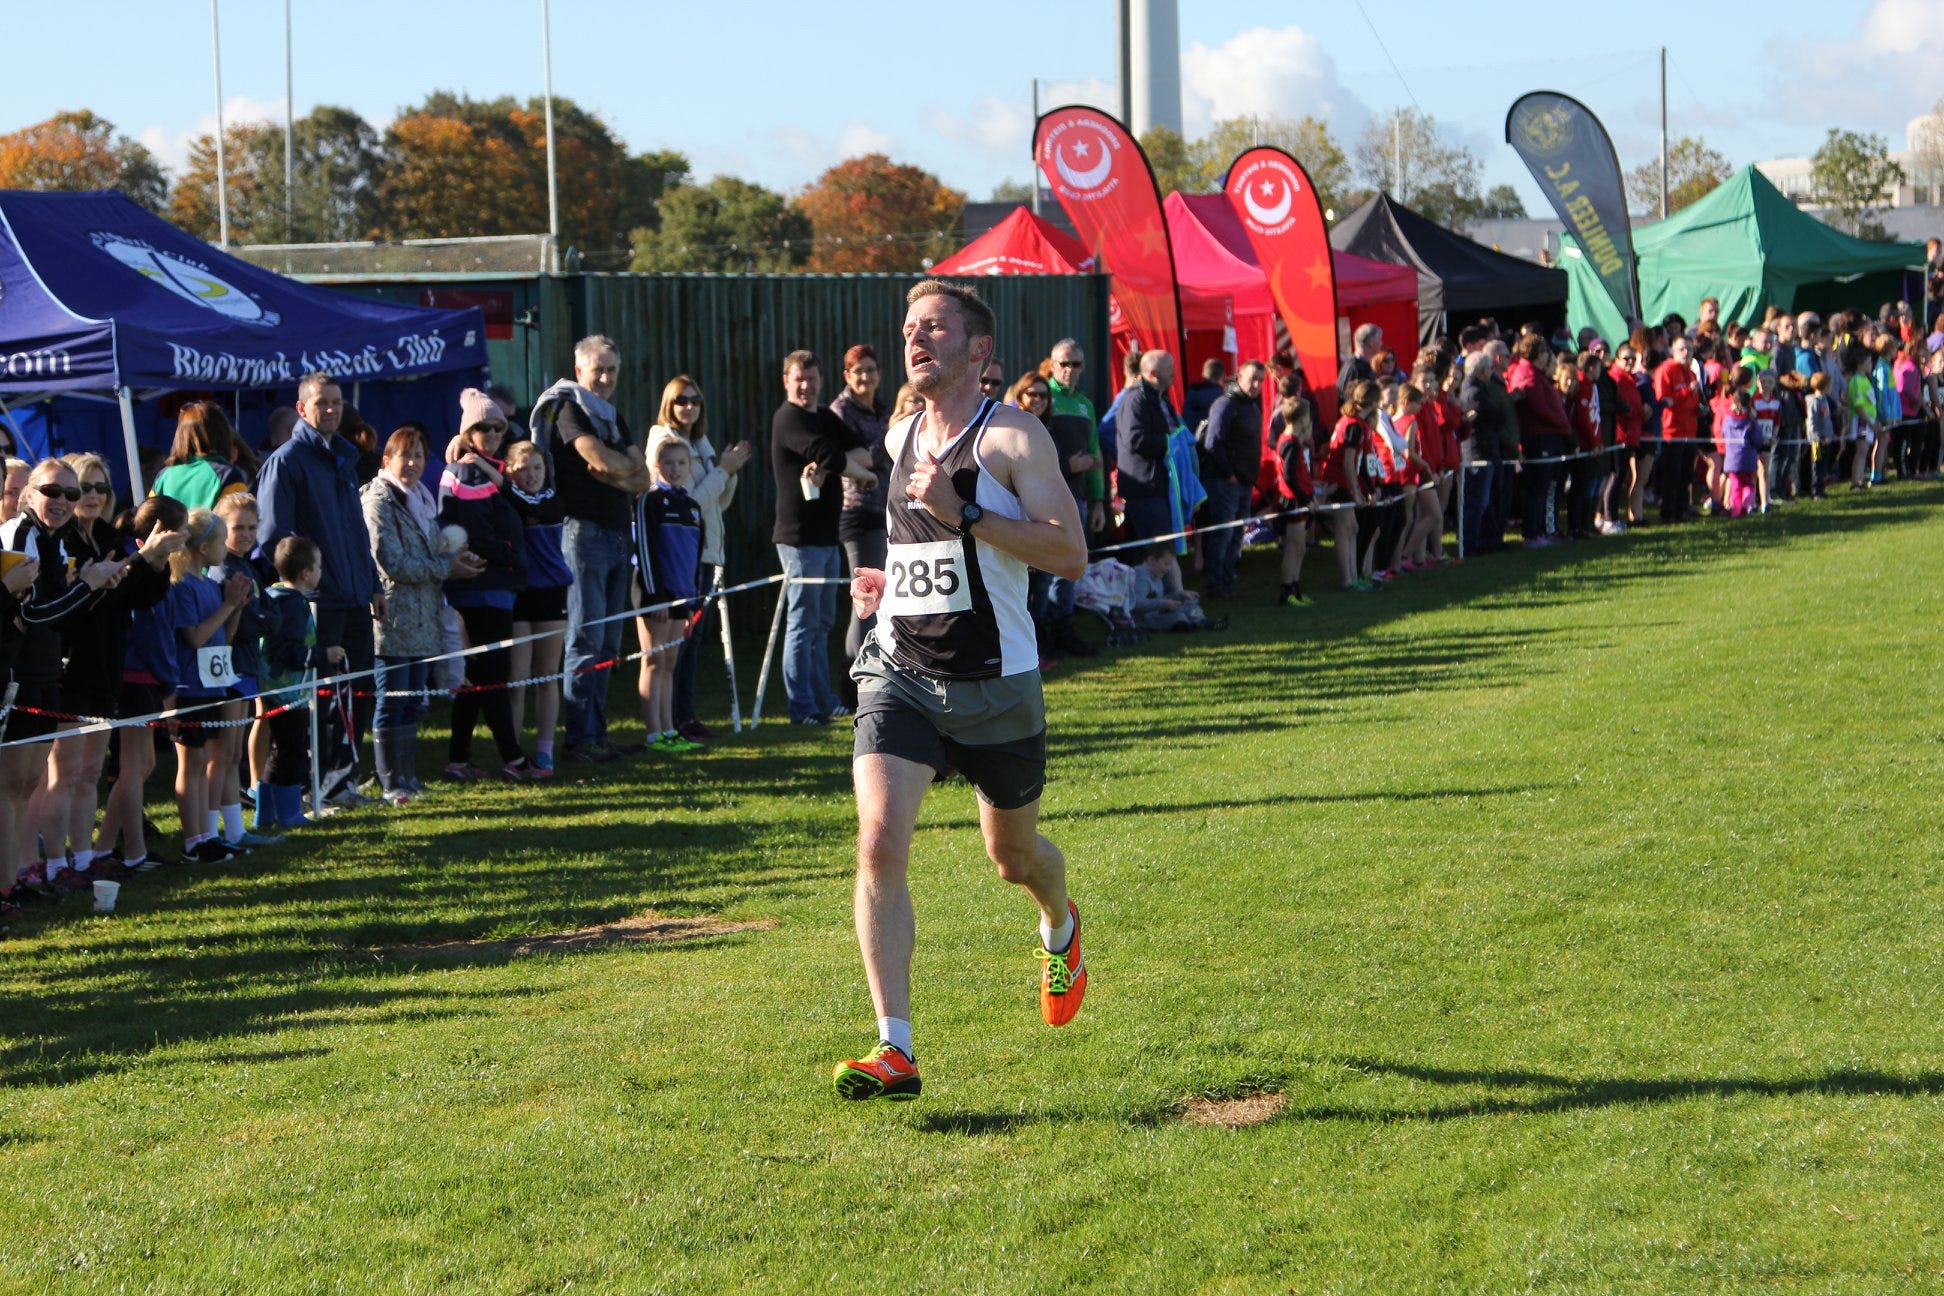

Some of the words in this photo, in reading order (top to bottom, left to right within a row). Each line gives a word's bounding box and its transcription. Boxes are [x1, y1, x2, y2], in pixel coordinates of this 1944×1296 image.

[165, 340, 296, 387] Blackrock
[386, 328, 446, 371] Club
[891, 557, 960, 598] 285
